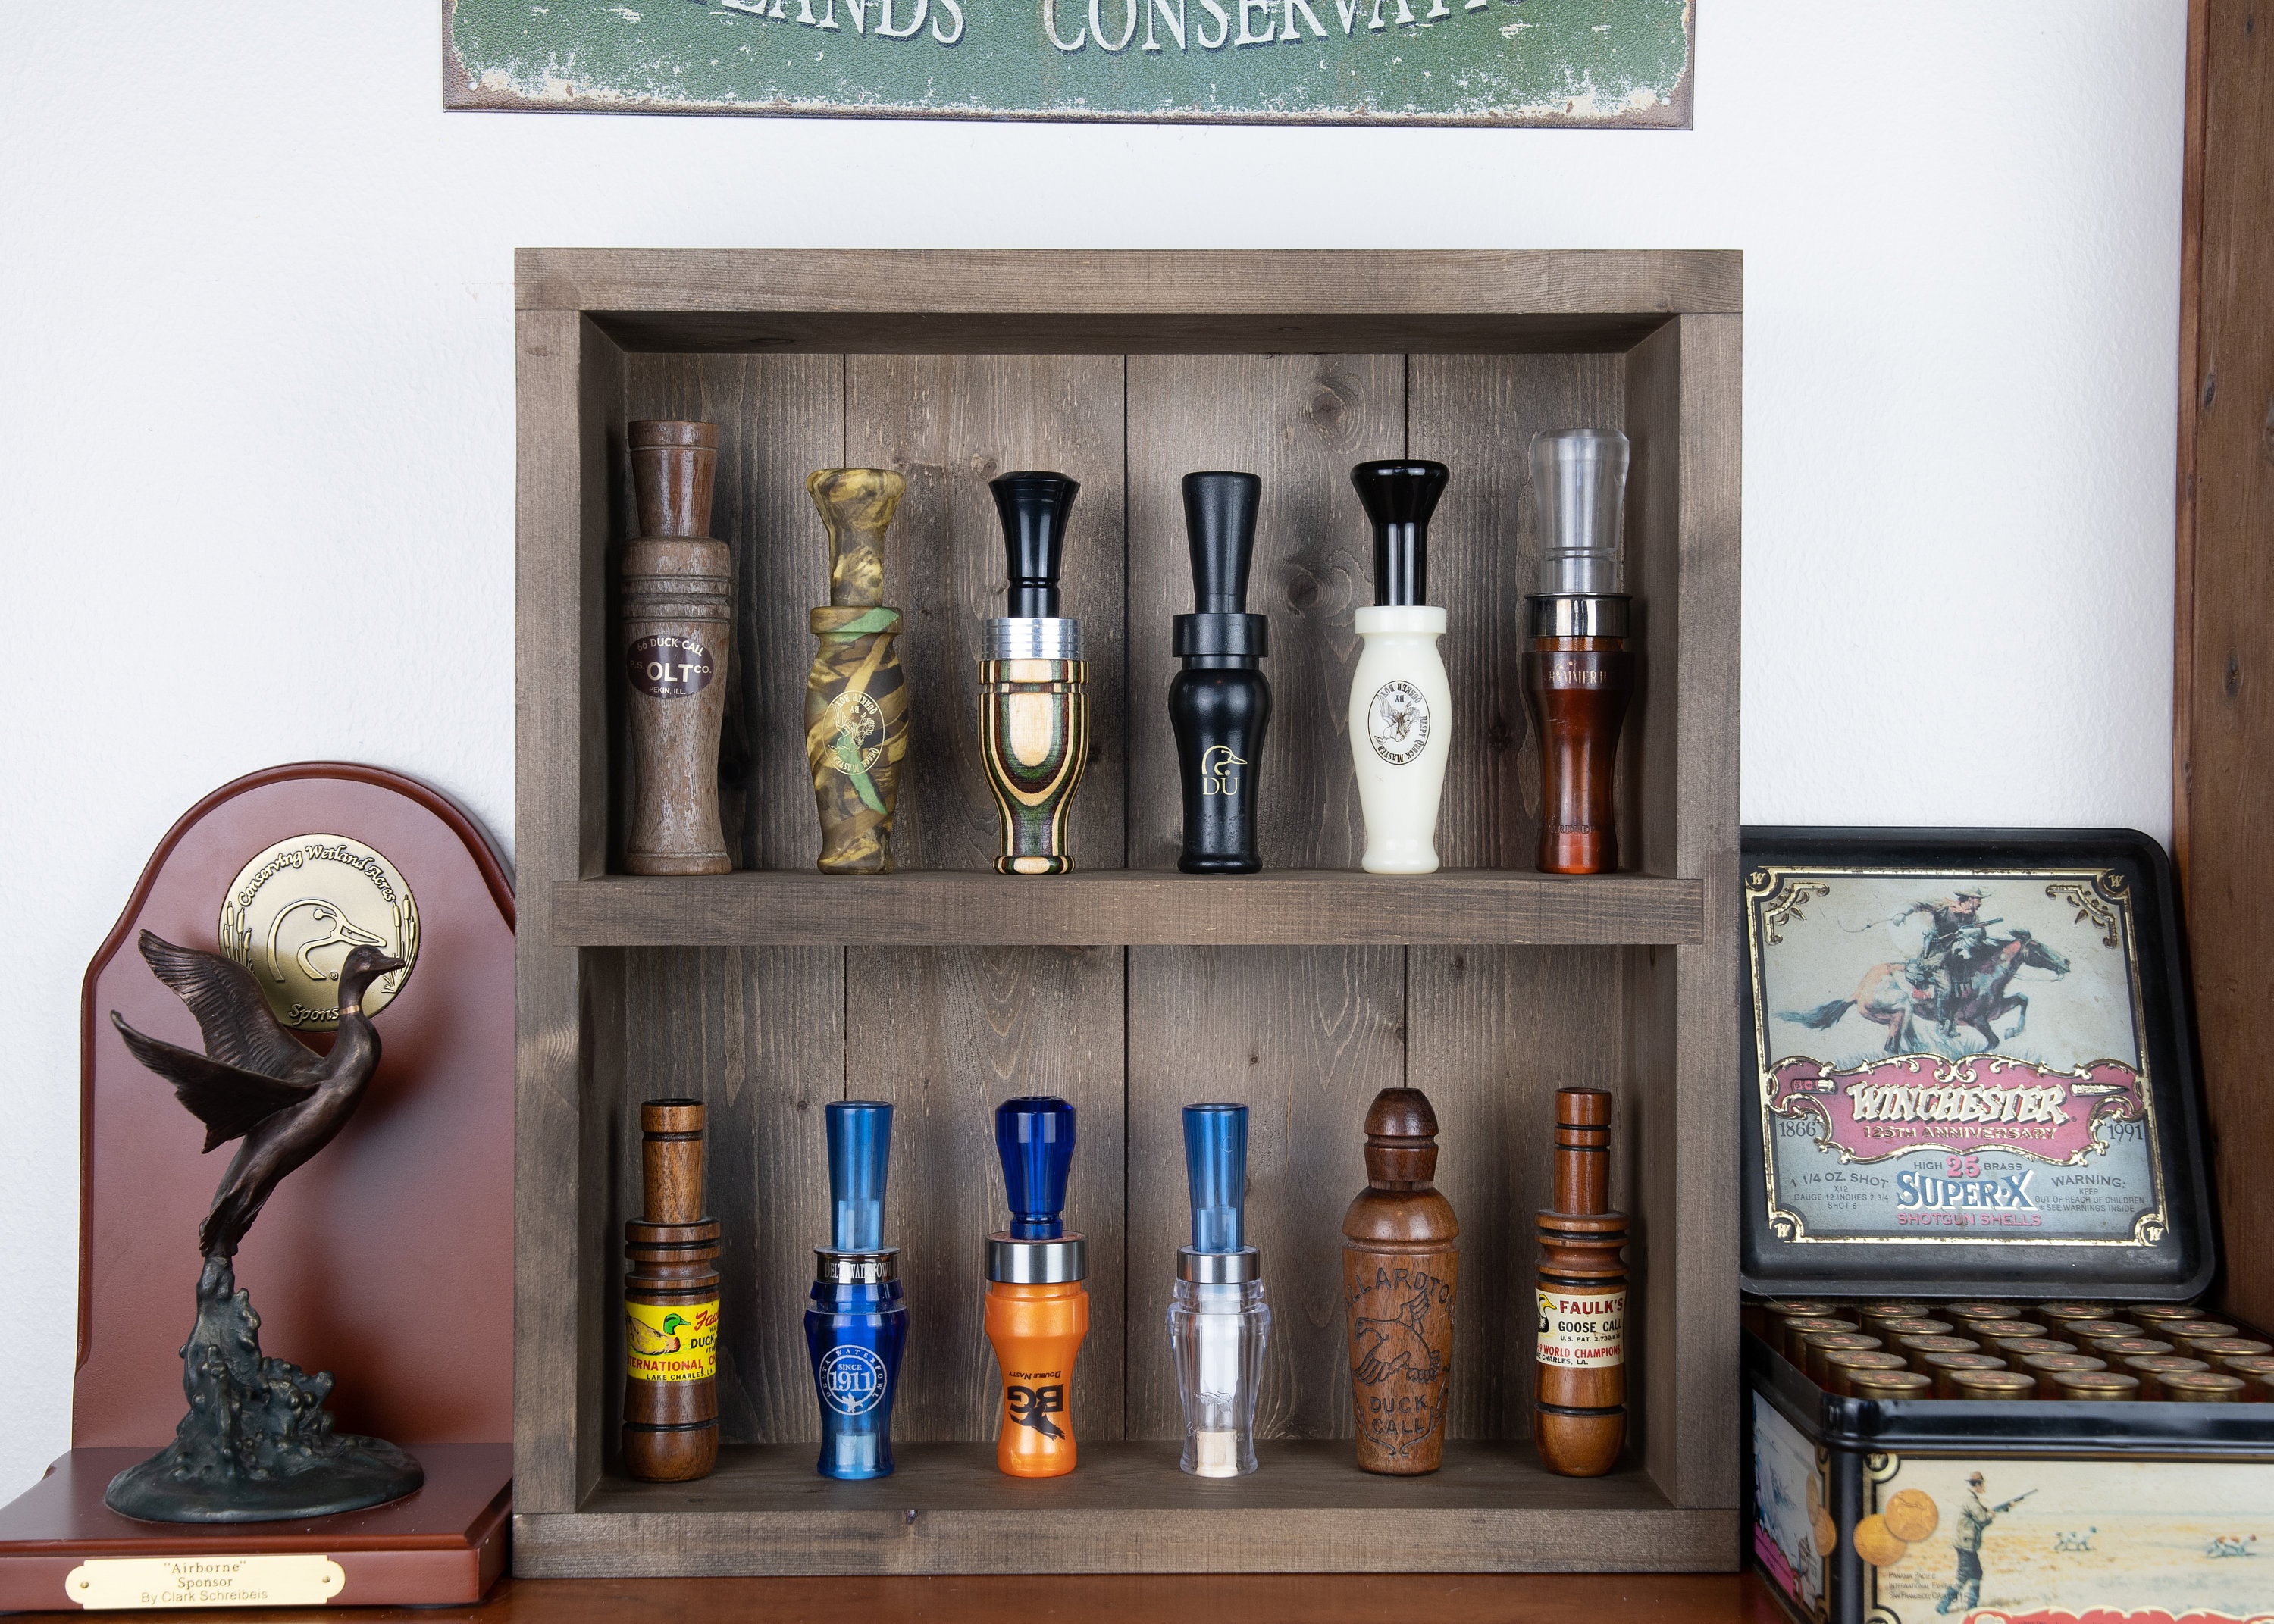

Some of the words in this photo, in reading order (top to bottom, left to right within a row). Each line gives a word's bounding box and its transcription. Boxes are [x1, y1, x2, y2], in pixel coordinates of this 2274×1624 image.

[637, 640, 647, 652] 66
[650, 637, 678, 648] DUCK
[681, 640, 704, 657] CALL
[630, 660, 644, 669] P.S.
[647, 662, 693, 682] OLT
[694, 665, 712, 674] CO.
[649, 686, 672, 694] PEKIN,
[1397, 683, 1423, 703] QUAKER
[852, 693, 878, 715] QUAKER
[1202, 777, 1239, 795] DU
[238, 849, 303, 907] Conserving
[305, 845, 373, 871] Wetland
[365, 865, 396, 902] Acres
[288, 1003, 340, 1025] Spons
[1845, 1081, 2070, 1125] WINCHESTER
[1779, 1121, 1816, 1137] 1866
[1864, 1125, 1917, 1138] 125TH
[1922, 1126, 2057, 1140] ANNIVERSARY
[2107, 1124, 2143, 1142] 1991
[1946, 1155, 1981, 1178] 25
[1984, 1162, 2022, 1171] BRASS
[1790, 1178, 1797, 1187] 1
[1803, 1173, 1821, 1184] 1/4
[1825, 1172, 1846, 1181] OZ.
[1850, 1173, 1889, 1188] SHOT
[2051, 1175, 2125, 1188] WARNING:
[1897, 1213, 1975, 1225] SHOTGUN
[1981, 1213, 2042, 1226] SHELLS
[1560, 1297, 1622, 1315] FAULK'S
[1558, 1321, 1596, 1332] GOOSE
[1602, 1319, 1621, 1331] CALL
[691, 1335, 714, 1349] DUCK
[1543, 1345, 1570, 1357] WORLD
[1574, 1345, 1621, 1358] CHAMPIONS
[628, 1356, 703, 1371] TERNATIONAL
[822, 1360, 831, 1398] DELTA
[835, 1348, 883, 1397] WATERFOWL
[828, 1371, 872, 1391] 1911
[1370, 1394, 1428, 1414] DUCK
[1372, 1418, 1425, 1435] CALL
[163, 1561, 246, 1575] "Airborne"
[178, 1577, 233, 1589] Sponsor
[141, 1593, 156, 1604] By
[161, 1591, 195, 1602] Clark
[200, 1589, 268, 1601] Schreibeis
